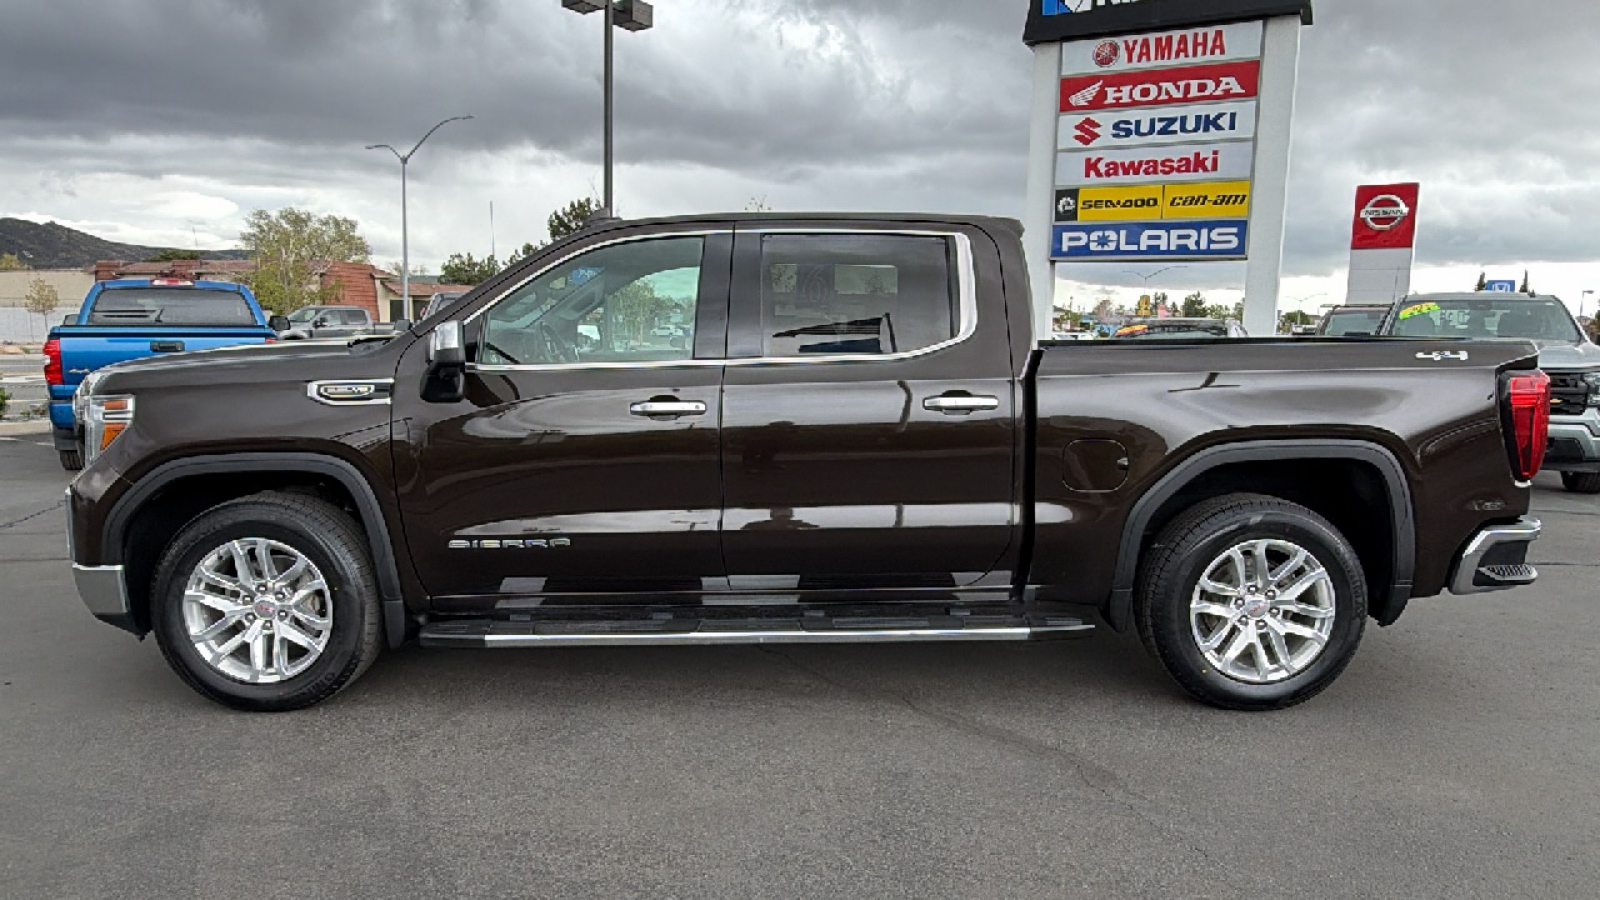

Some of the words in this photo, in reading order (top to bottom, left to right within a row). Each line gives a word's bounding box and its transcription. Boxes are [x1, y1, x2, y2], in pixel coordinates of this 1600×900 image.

[1123, 29, 1226, 64] YAMAHA
[1103, 76, 1246, 105] HONDA
[1110, 111, 1237, 139] SUZUKI
[1084, 150, 1219, 178] Kawasaki
[1169, 194, 1247, 207] can-am
[1364, 208, 1404, 217] NISSAN
[1060, 227, 1240, 252] POLARIS
[447, 538, 571, 549] SIERRA
